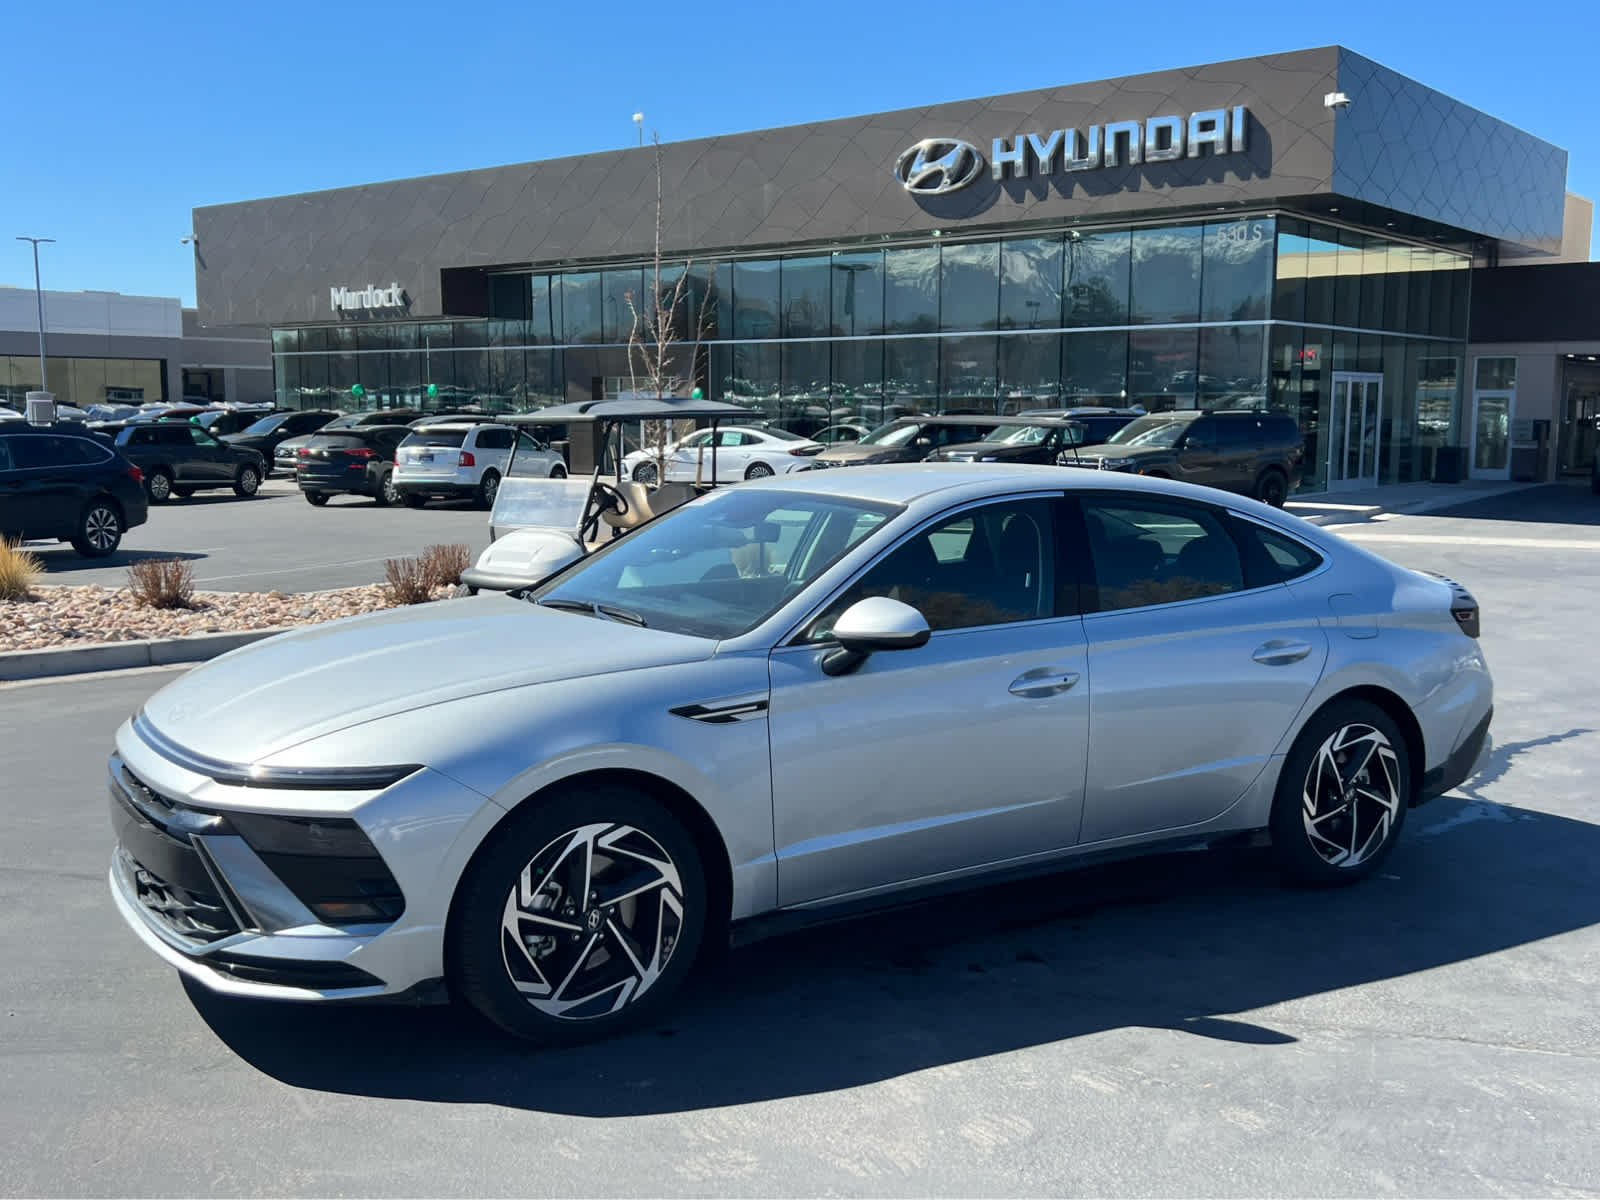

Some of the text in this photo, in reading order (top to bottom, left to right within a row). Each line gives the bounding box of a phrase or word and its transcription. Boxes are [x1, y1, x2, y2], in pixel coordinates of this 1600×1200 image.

[991, 104, 1247, 180] HYUNDAI
[1252, 224, 1262, 241] S
[330, 282, 404, 311] Murdock
